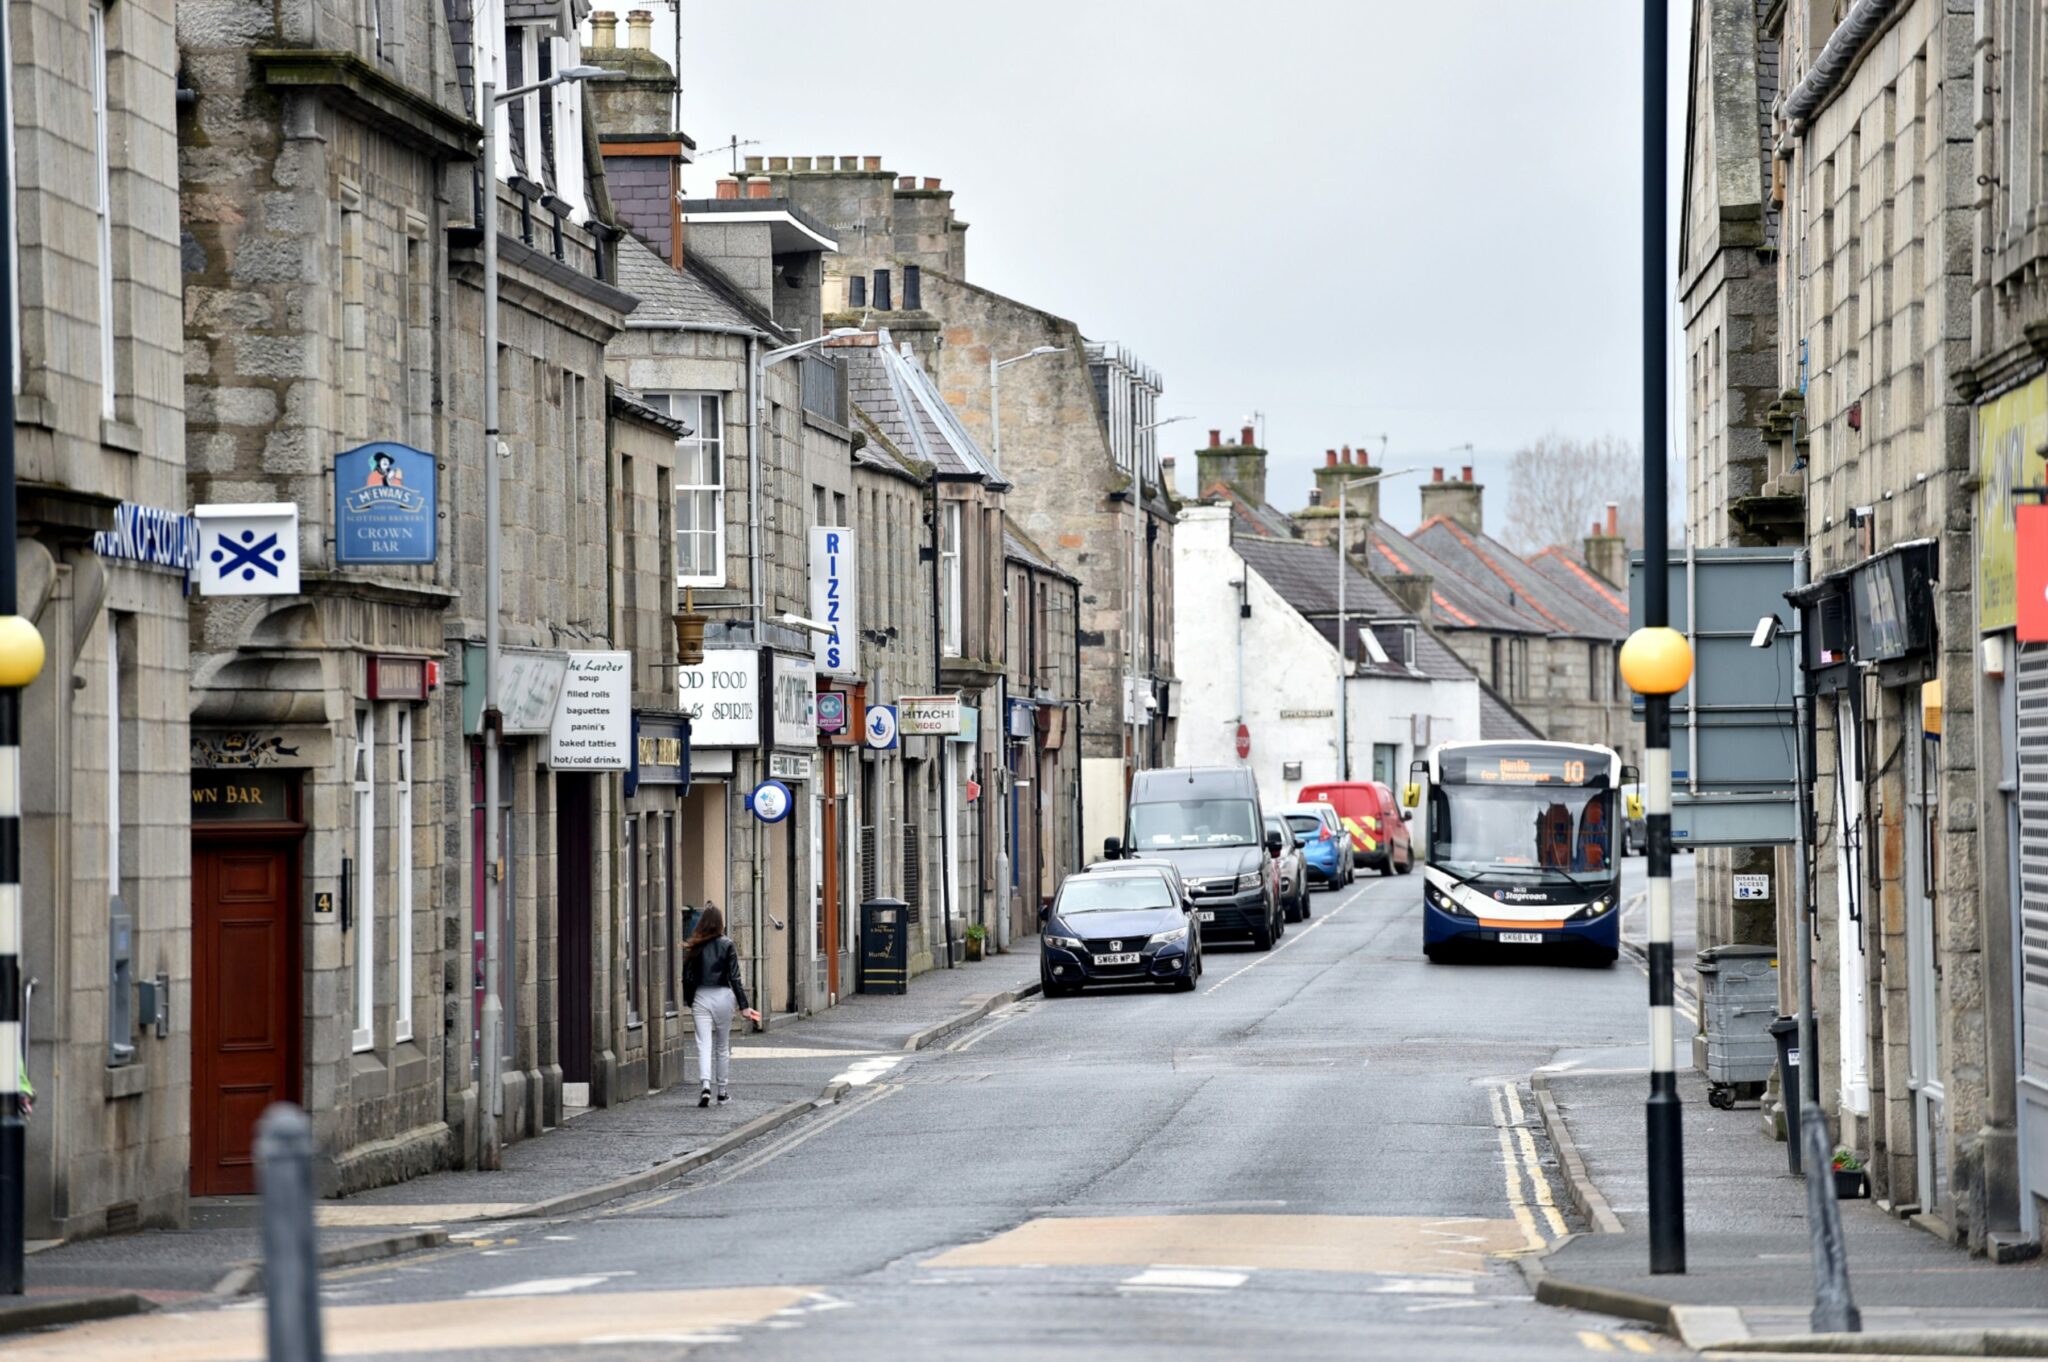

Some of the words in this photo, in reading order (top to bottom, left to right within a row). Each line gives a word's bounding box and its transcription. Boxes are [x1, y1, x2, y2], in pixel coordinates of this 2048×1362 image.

[136, 505, 152, 561] OF
[357, 527, 413, 539] CROWN
[372, 540, 400, 553] BAR
[826, 532, 840, 668] RIZZAS
[568, 660, 581, 672] he
[584, 659, 624, 672] Larder
[578, 674, 600, 683] soup
[679, 671, 704, 689] OD
[711, 671, 748, 689] FOOD
[567, 690, 589, 698] filled
[591, 690, 611, 698] rolls
[566, 706, 611, 716] baguettes
[711, 702, 753, 720] SPIRITS
[902, 709, 955, 719] HITACHI
[571, 723, 606, 732] panini's
[559, 739, 586, 747] baked
[588, 739, 617, 747] tatties
[1236, 736, 1249, 747] STOP
[554, 755, 592, 764] hot/cold
[594, 755, 622, 764] drinks
[1563, 760, 1584, 782] 10
[226, 785, 263, 804] BAR
[1505, 892, 1547, 901] Stagecoach
[318, 894, 330, 912] 4
[1096, 955, 1118, 964] SW66
[1120, 954, 1136, 963] WPZ
